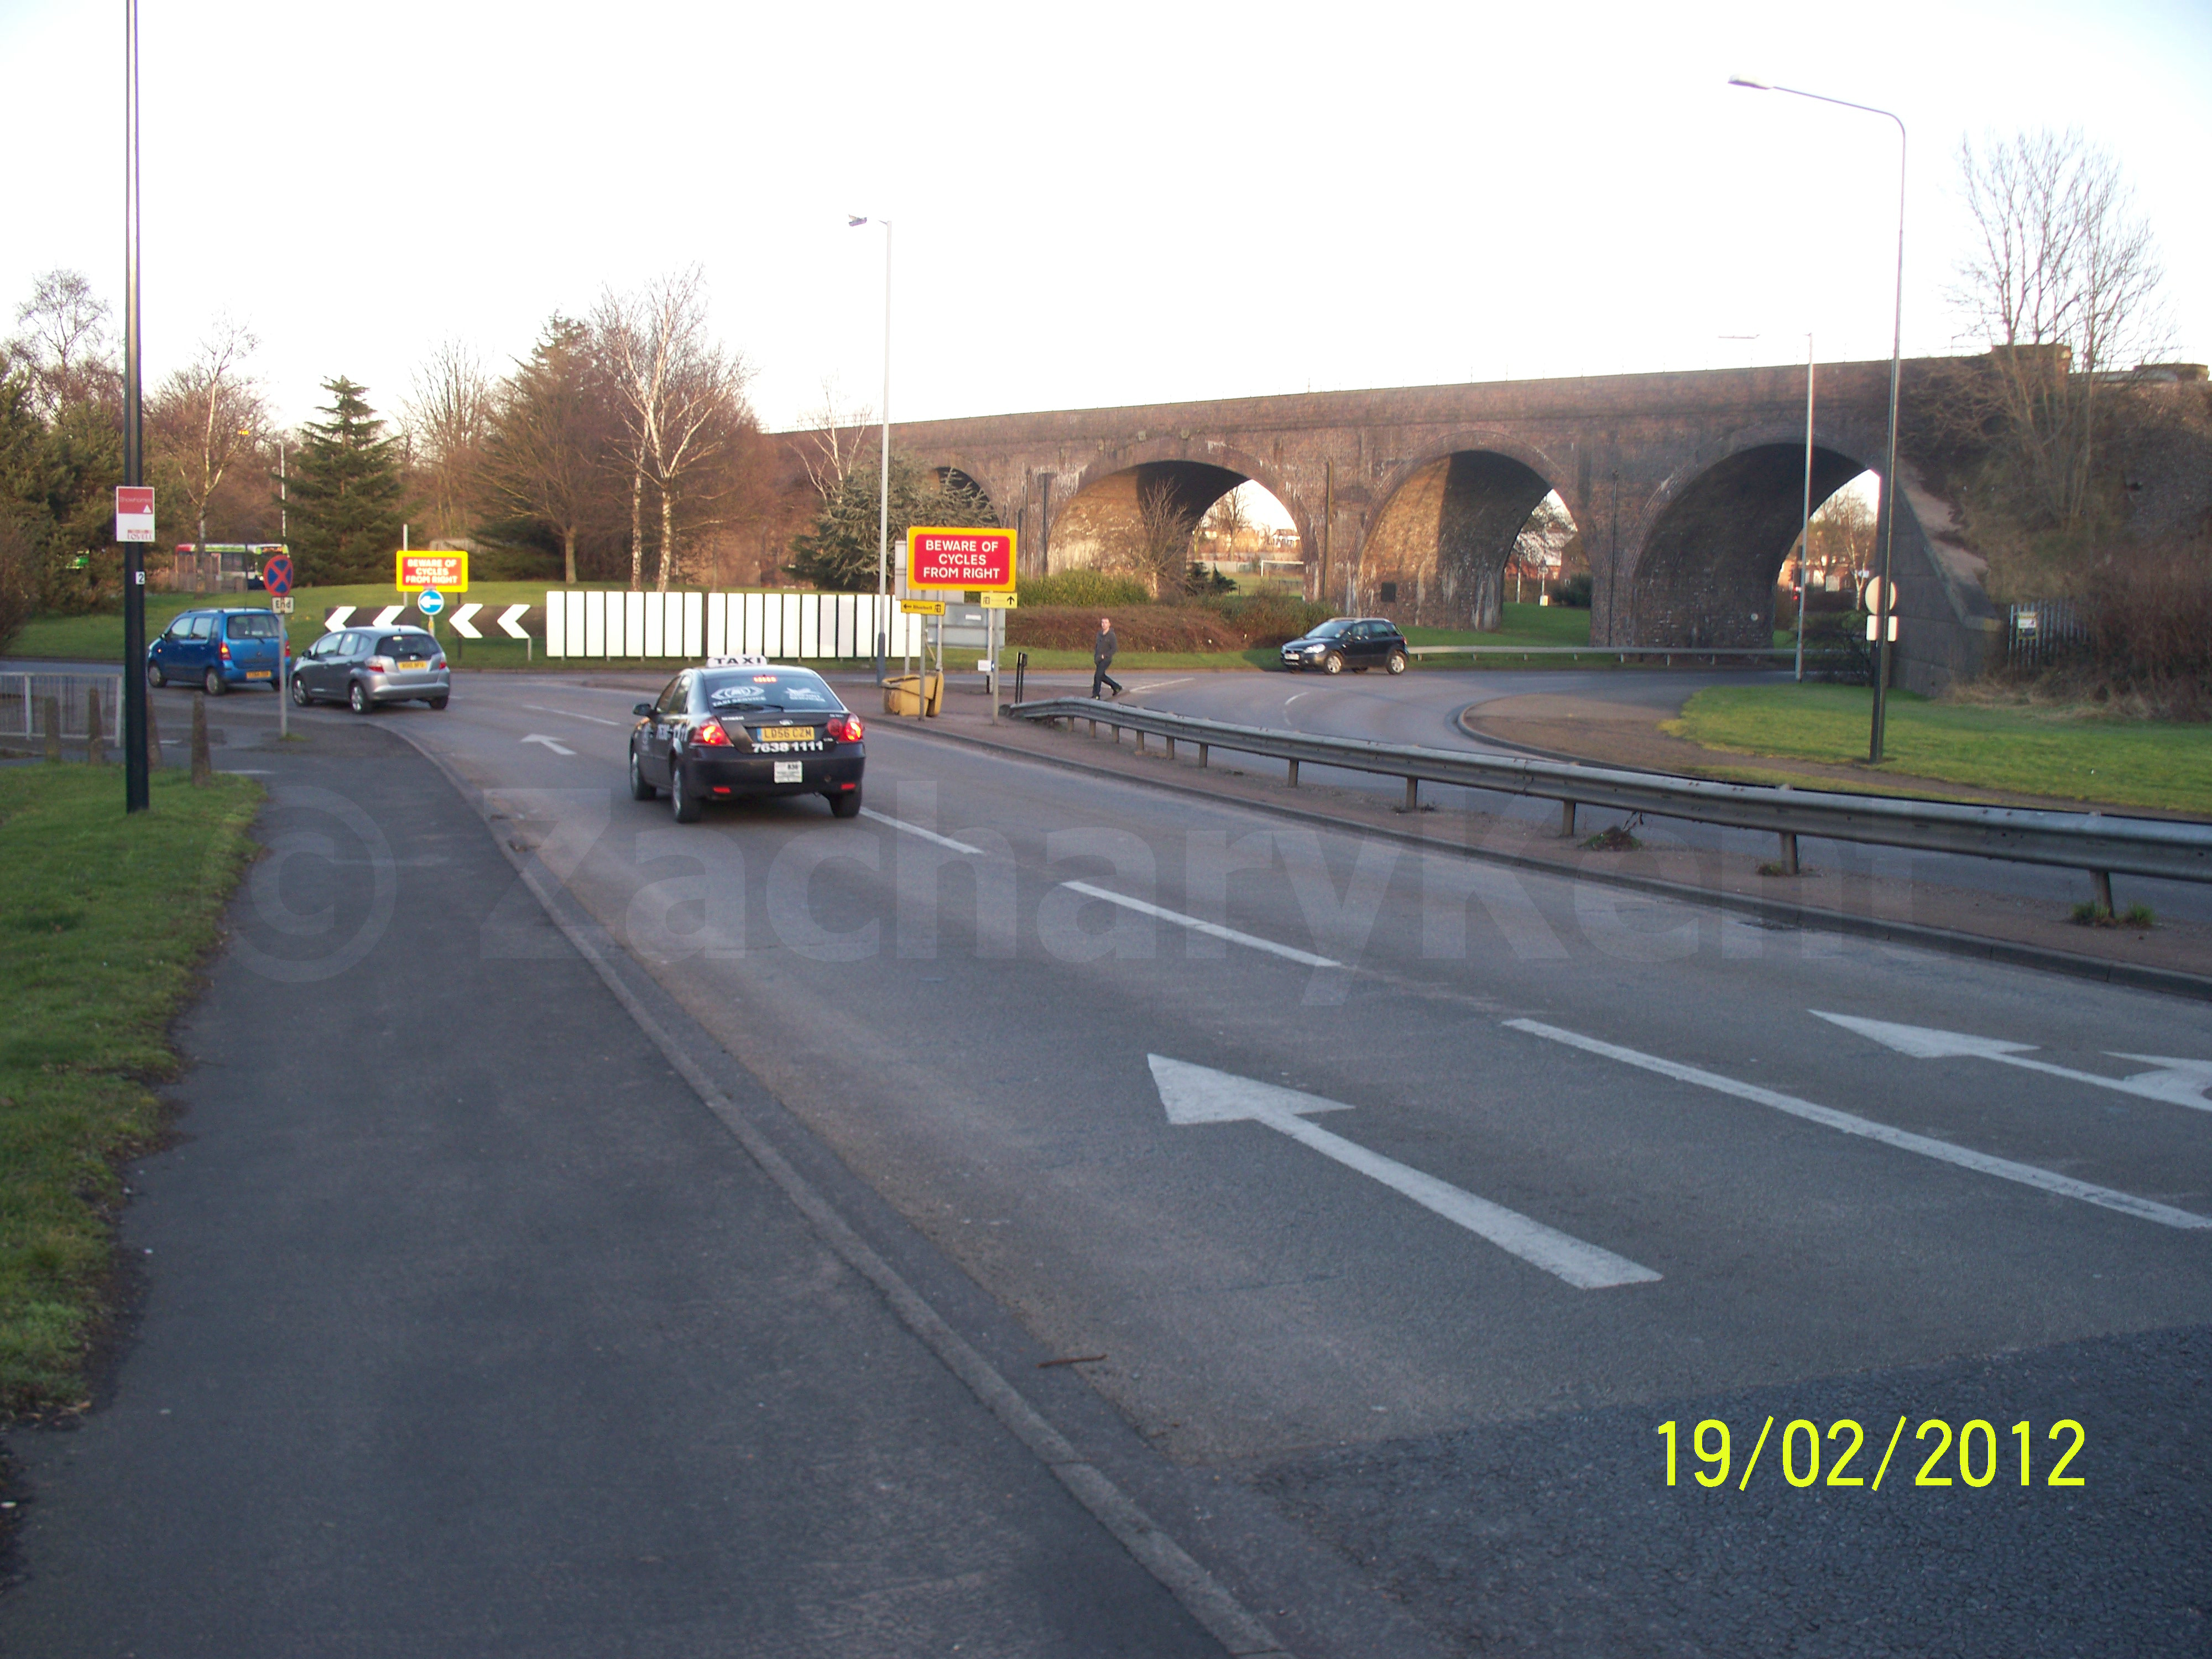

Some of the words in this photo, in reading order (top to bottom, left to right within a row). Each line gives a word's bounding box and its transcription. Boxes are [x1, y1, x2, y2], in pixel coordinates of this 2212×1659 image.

[926, 540, 977, 552] BEWARE
[982, 541, 999, 552] OF
[408, 559, 443, 567] BEWARE
[445, 559, 457, 567] OF
[938, 554, 987, 565] CYCLES
[138, 573, 144, 582] 2
[923, 567, 959, 578] FROM
[963, 567, 1000, 579] RIGHT
[405, 575, 430, 583] FROM
[275, 598, 291, 609] End
[752, 742, 790, 753] 7638
[791, 740, 823, 752] 1111
